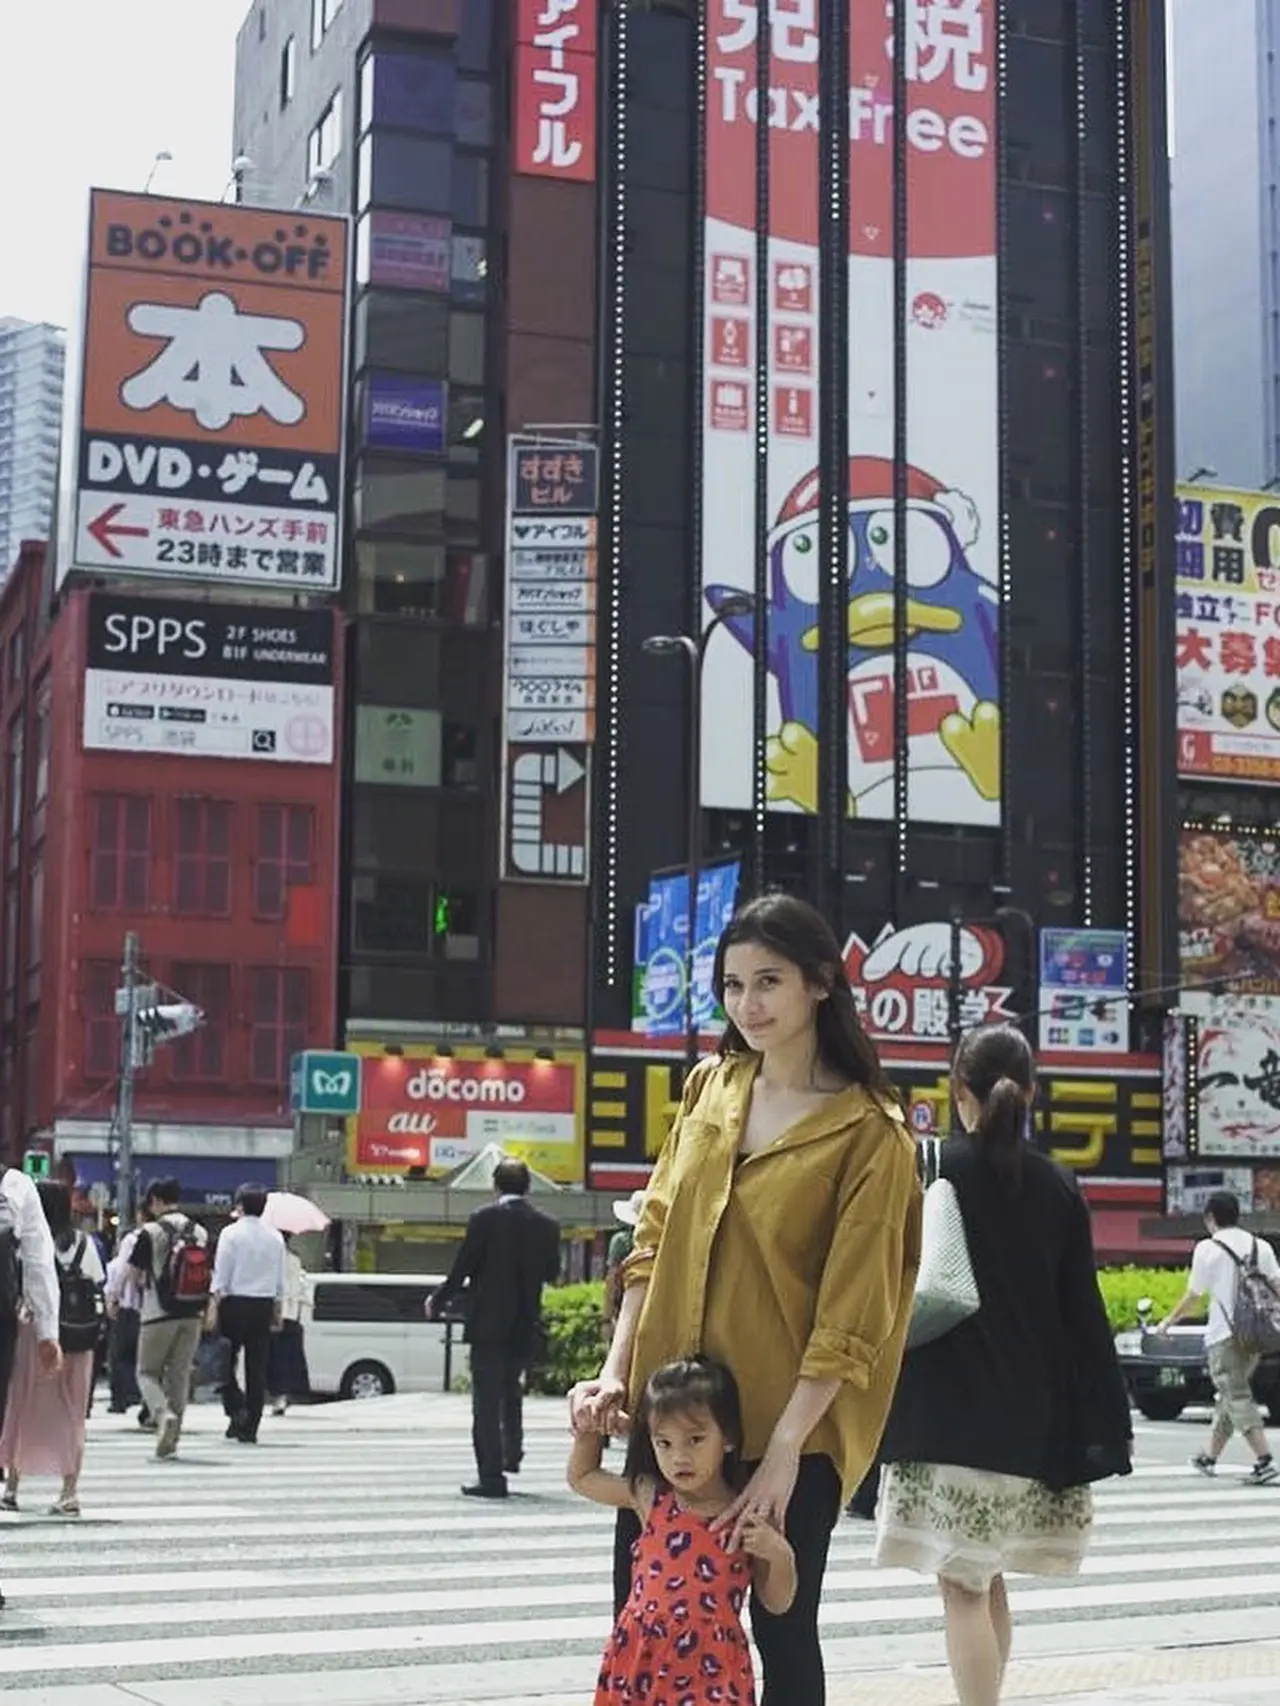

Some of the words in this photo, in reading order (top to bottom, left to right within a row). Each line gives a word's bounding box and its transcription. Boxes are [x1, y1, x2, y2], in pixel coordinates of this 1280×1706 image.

[714, 67, 820, 132] Tax
[849, 86, 989, 159] Free
[118, 289, 307, 431] 本
[157, 507, 329, 546] 東急ハンズ手前
[156, 538, 327, 577] 23時まで営業
[104, 612, 208, 659] SPPS
[251, 627, 298, 645] SHOES
[252, 648, 328, 665] UNDERWEAR
[387, 1111, 438, 1135] au
